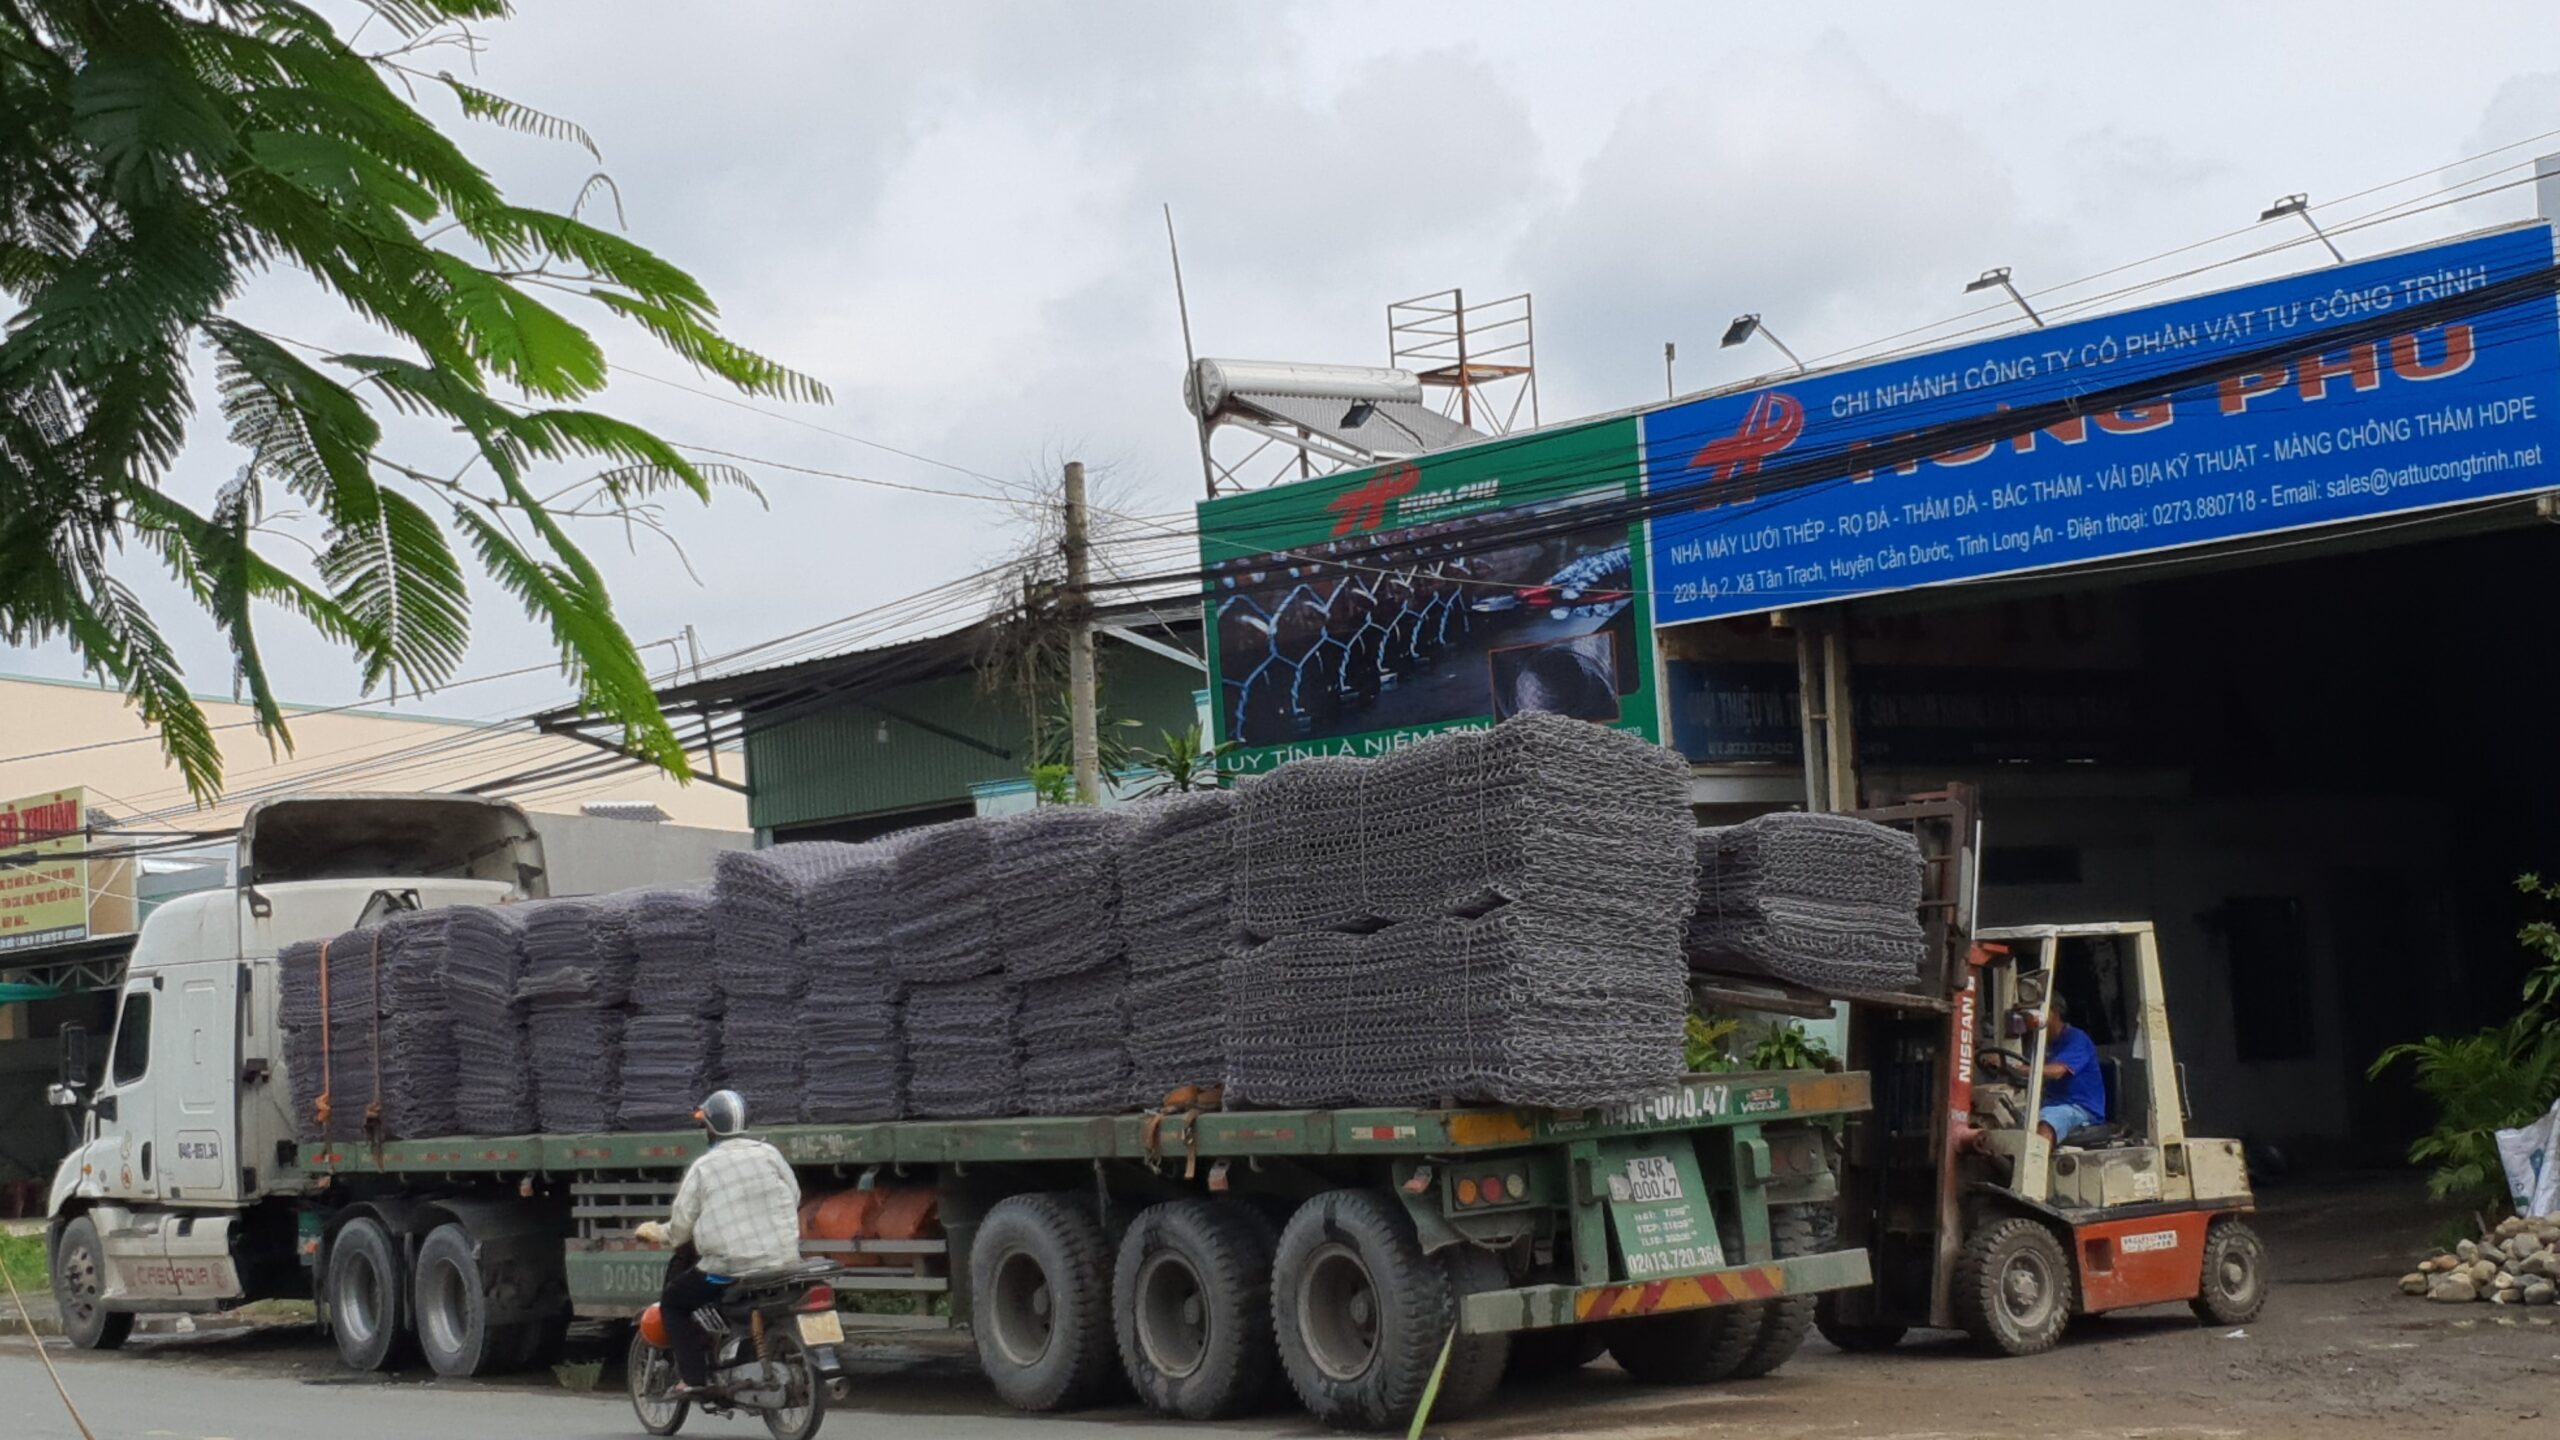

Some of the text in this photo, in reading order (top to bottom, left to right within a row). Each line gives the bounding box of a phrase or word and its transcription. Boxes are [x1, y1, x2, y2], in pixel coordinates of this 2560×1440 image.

[1831, 390, 1869, 418] CHI
[1876, 373, 1957, 409] NHÁNH
[1964, 357, 2036, 391] CÔNG
[2041, 348, 2073, 373] TY
[2310, 289, 2393, 321] CÔNG
[1671, 543, 1704, 565] NHÀ
[1706, 535, 1737, 558] MÁY
[1742, 526, 1780, 554] LƯỚI
[1783, 518, 1825, 545] THÉP
[1839, 514, 1863, 539] RỌ
[1867, 504, 1890, 529] ĐÁ
[1954, 489, 1979, 514] ĐÁ
[2131, 463, 2162, 489] ĐỊA
[2196, 444, 2257, 473] THUẬT
[2274, 431, 2332, 462] MÀNG
[2479, 396, 2537, 428] HDPE
[1674, 582, 1697, 604] 228
[1737, 573, 1755, 594] Xã
[1757, 569, 1783, 591] Tân
[1786, 562, 1827, 588] Trạch,
[1830, 554, 1874, 581] Huyện
[1993, 531, 2029, 553] Long
[2033, 525, 2053, 545] An
[2067, 513, 2103, 540] Điện
[2106, 507, 2149, 533] thoại:
[2153, 490, 2256, 525] 0273.880718
[2271, 480, 2322, 507] Email:
[2327, 444, 2542, 499] sales@vattucongtrinh.net
[1227, 753, 1264, 772] UY
[1958, 997, 1974, 1083] NISSAN
[1633, 1176, 1678, 1199] 000.47
[1638, 1158, 1666, 1179] 84R
